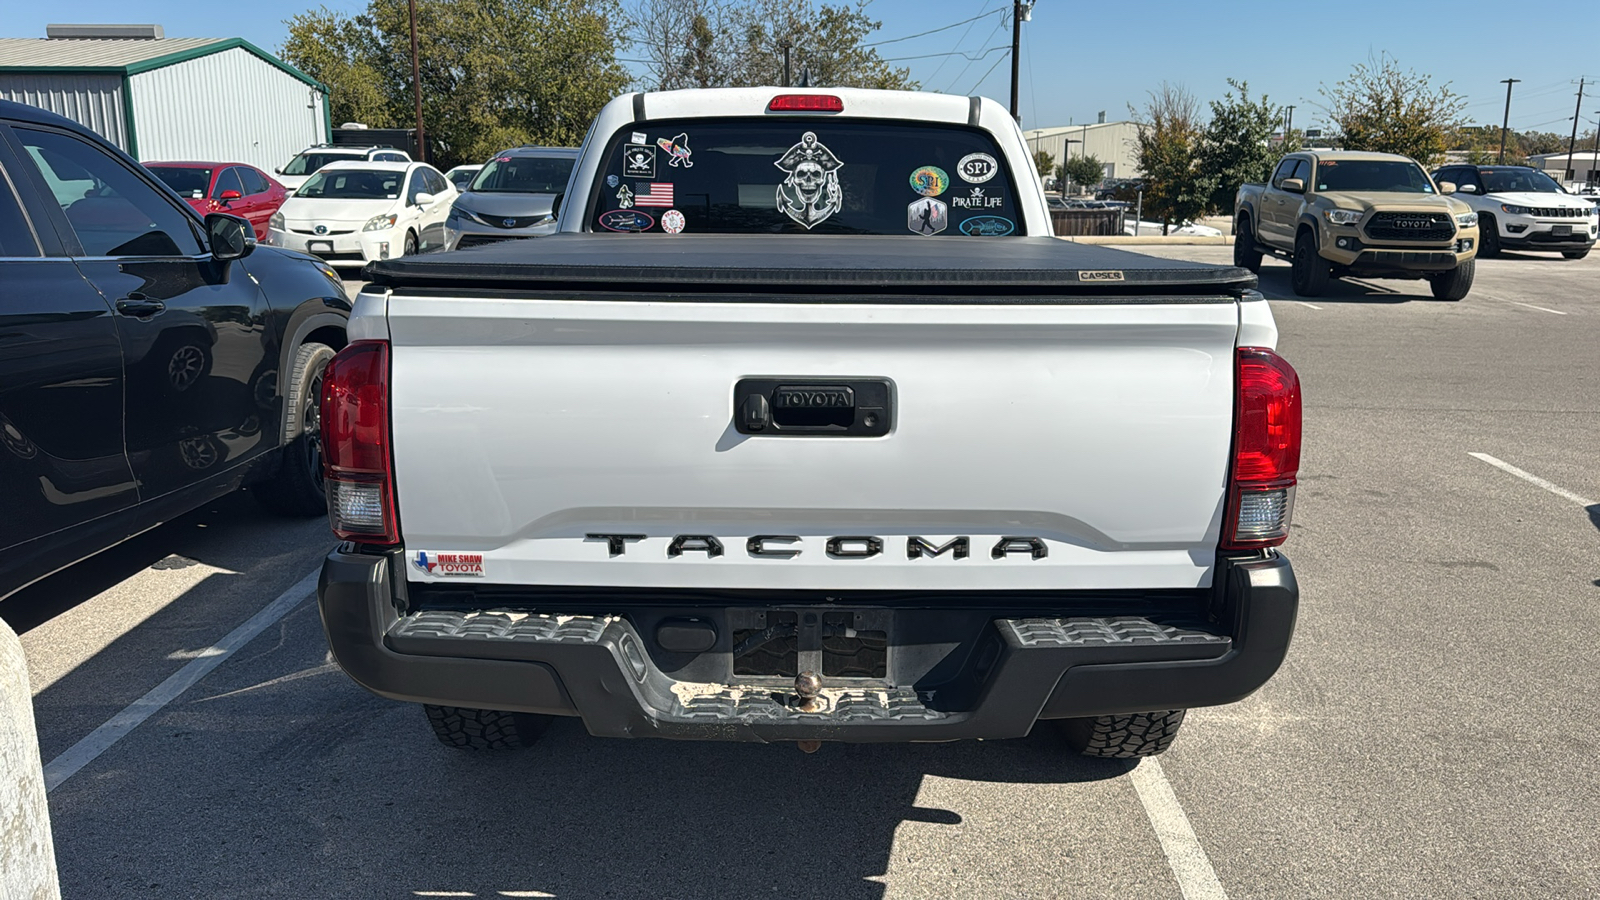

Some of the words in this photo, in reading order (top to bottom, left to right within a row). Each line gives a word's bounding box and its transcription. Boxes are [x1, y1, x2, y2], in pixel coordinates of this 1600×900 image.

[966, 162, 988, 175] SPI
[918, 174, 939, 187] SPI
[952, 196, 981, 209] PIRATE
[984, 196, 1002, 208] LIFE
[1395, 220, 1431, 228] TOYOTA
[778, 391, 849, 407] TOYOTA
[583, 533, 1049, 560] TACOMA
[438, 555, 457, 563] MIKE
[459, 555, 482, 563] SHAW
[439, 564, 482, 572] TOYOTA
